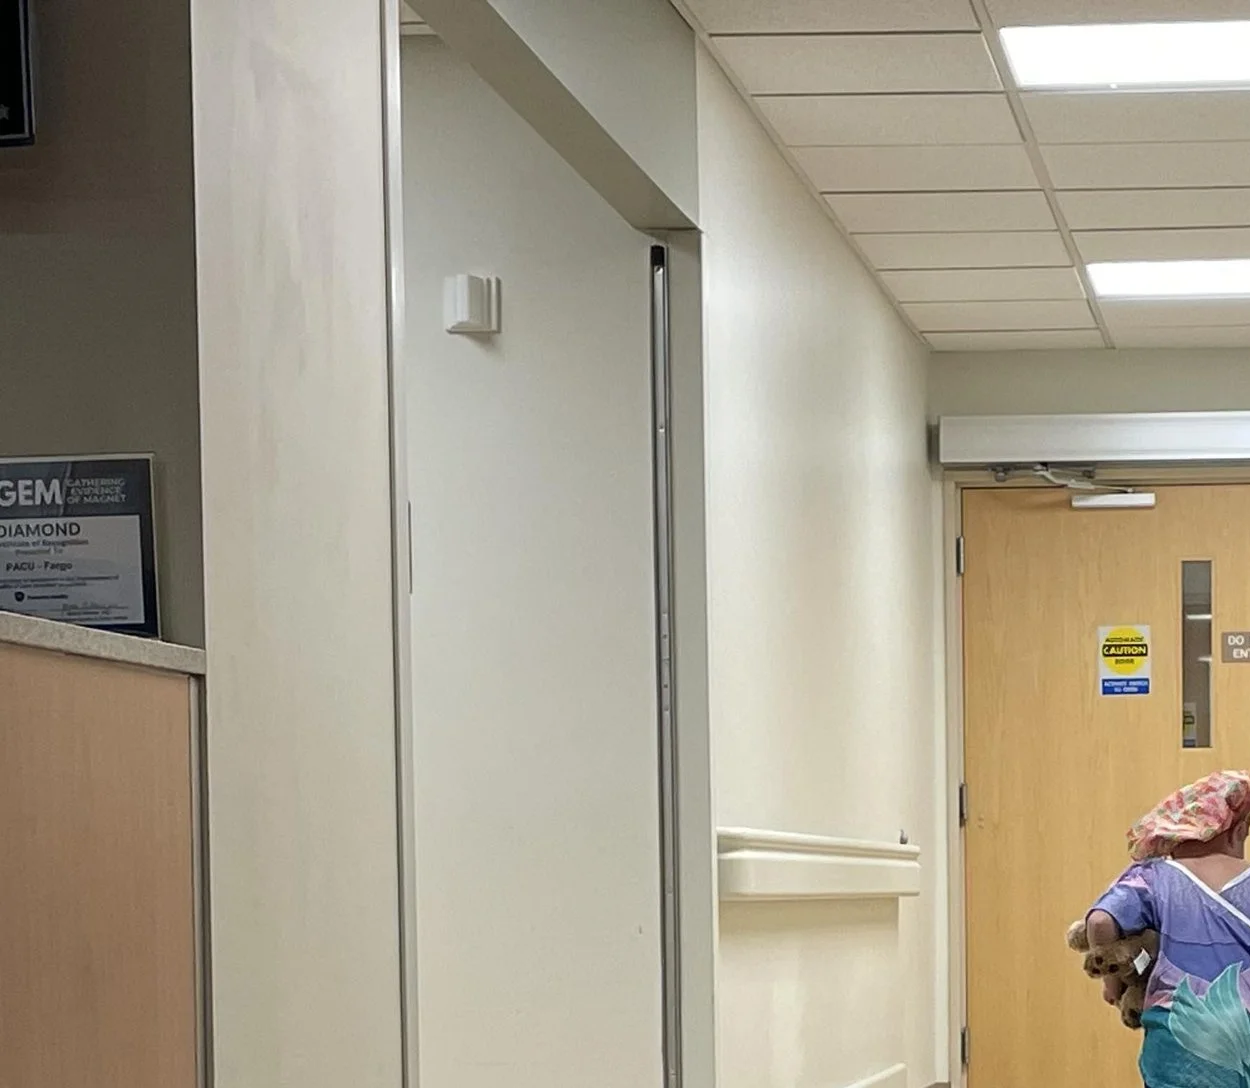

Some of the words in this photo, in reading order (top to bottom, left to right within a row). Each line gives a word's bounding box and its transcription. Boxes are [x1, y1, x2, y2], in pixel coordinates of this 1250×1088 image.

[0, 478, 63, 507] GEM
[0, 522, 81, 538] DIAMOND
[6, 561, 35, 572] PACU
[43, 560, 73, 572] Fargo
[1228, 635, 1244, 646] DO
[1103, 646, 1146, 655] CAUTION
